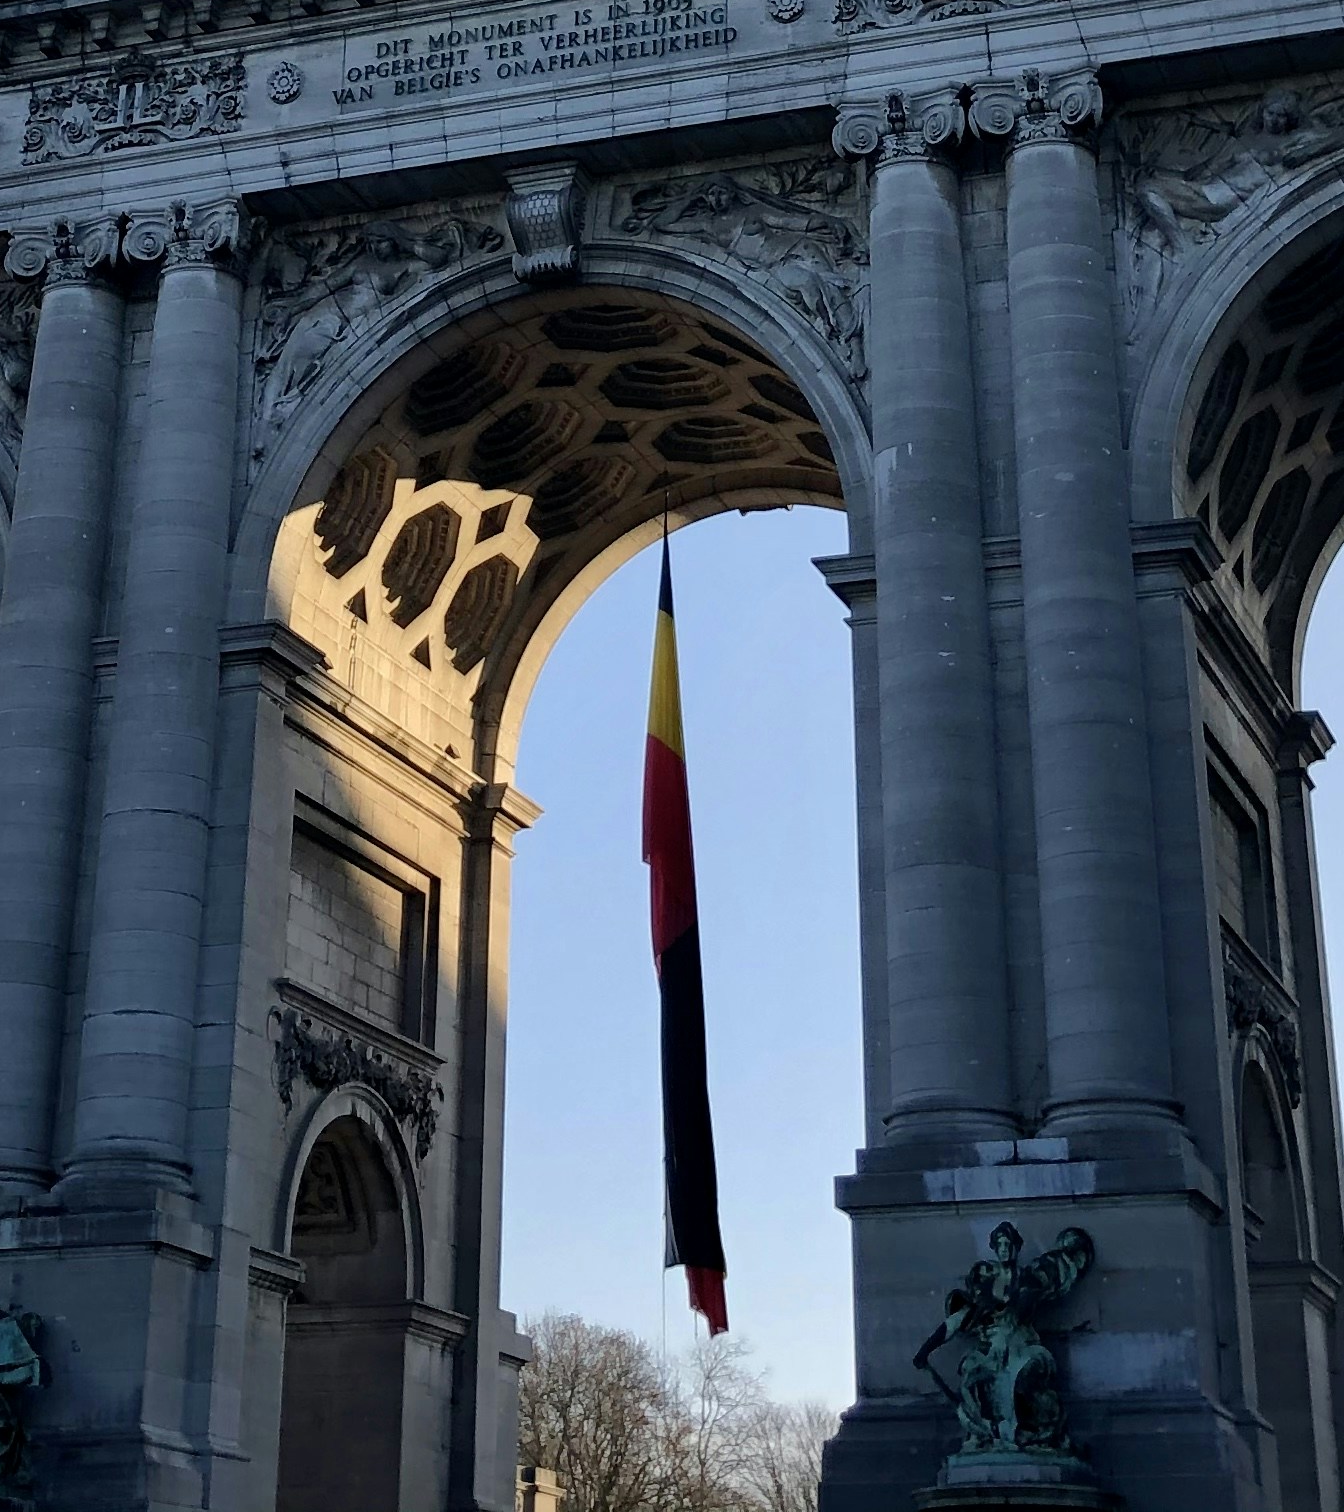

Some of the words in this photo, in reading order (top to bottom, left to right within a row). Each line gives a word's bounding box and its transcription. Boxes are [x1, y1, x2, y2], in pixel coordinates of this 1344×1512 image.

[331, 84, 374, 105] VAN
[496, 27, 738, 80] ONAFHANKELIJKHEID
[347, 49, 470, 83] OPGERICHT
[484, 41, 525, 61] TER
[539, 7, 725, 52] VERHEERLIJKING
[375, 38, 413, 59] DIT
[429, 14, 557, 51] MONUMENT
[574, 9, 593, 27] IS
[608, 1, 630, 21] IN
